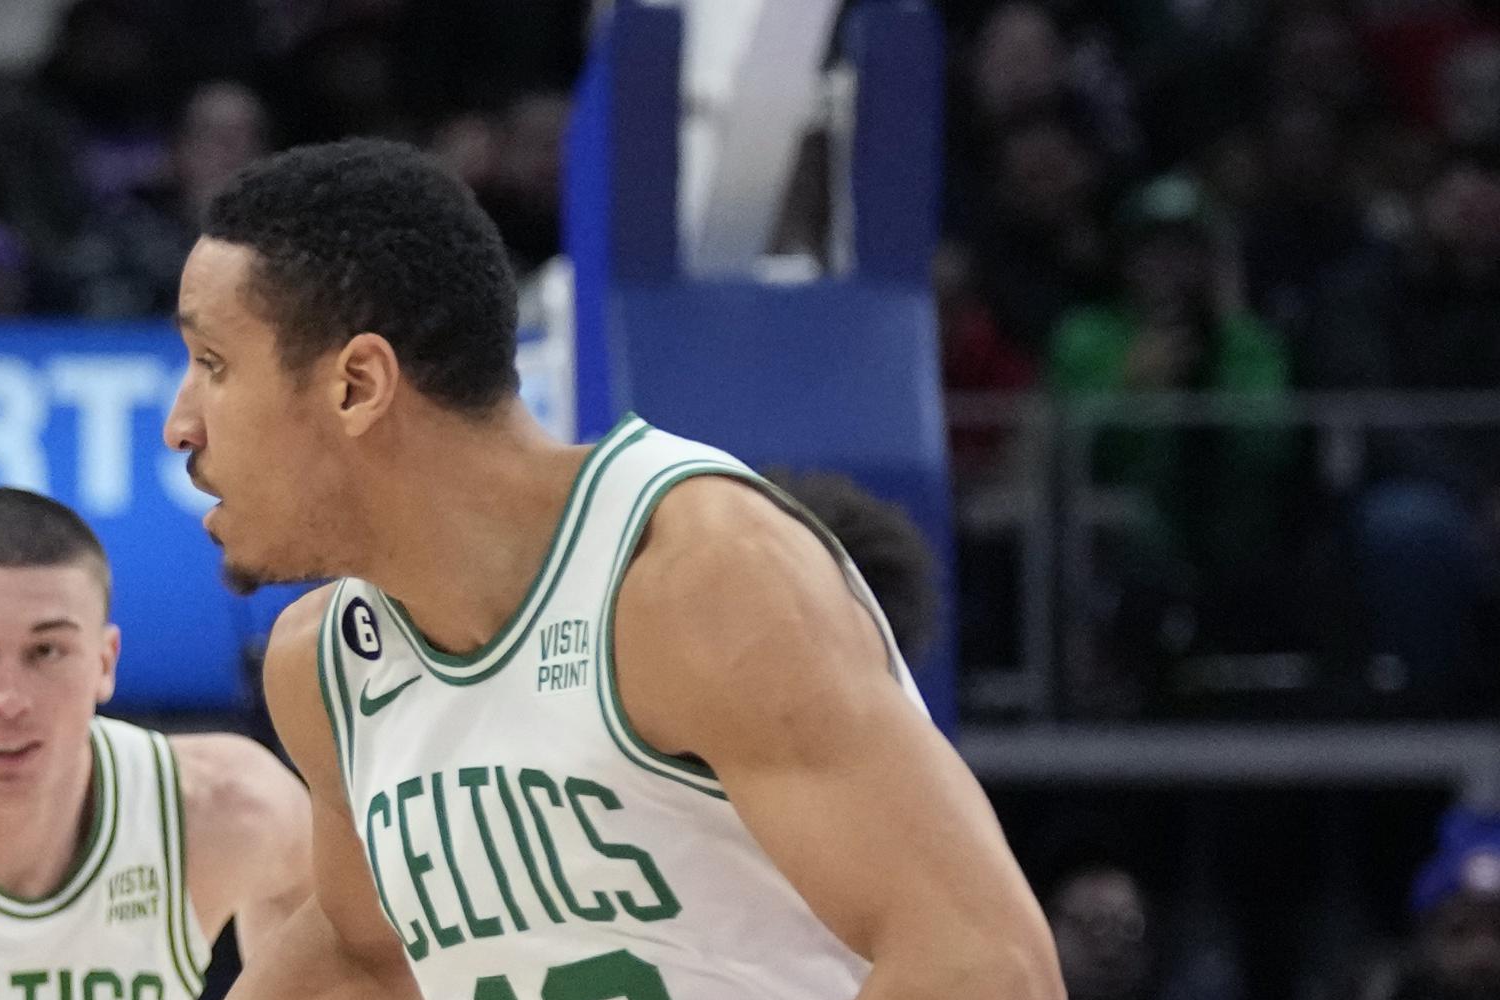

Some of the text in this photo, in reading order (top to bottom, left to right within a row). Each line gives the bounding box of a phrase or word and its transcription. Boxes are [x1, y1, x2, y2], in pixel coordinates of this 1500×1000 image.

[354, 604, 379, 653] 6
[539, 619, 590, 661] VISTA
[537, 659, 589, 692] PRINT
[108, 866, 160, 900] VISTA
[366, 765, 683, 962] CELTICS
